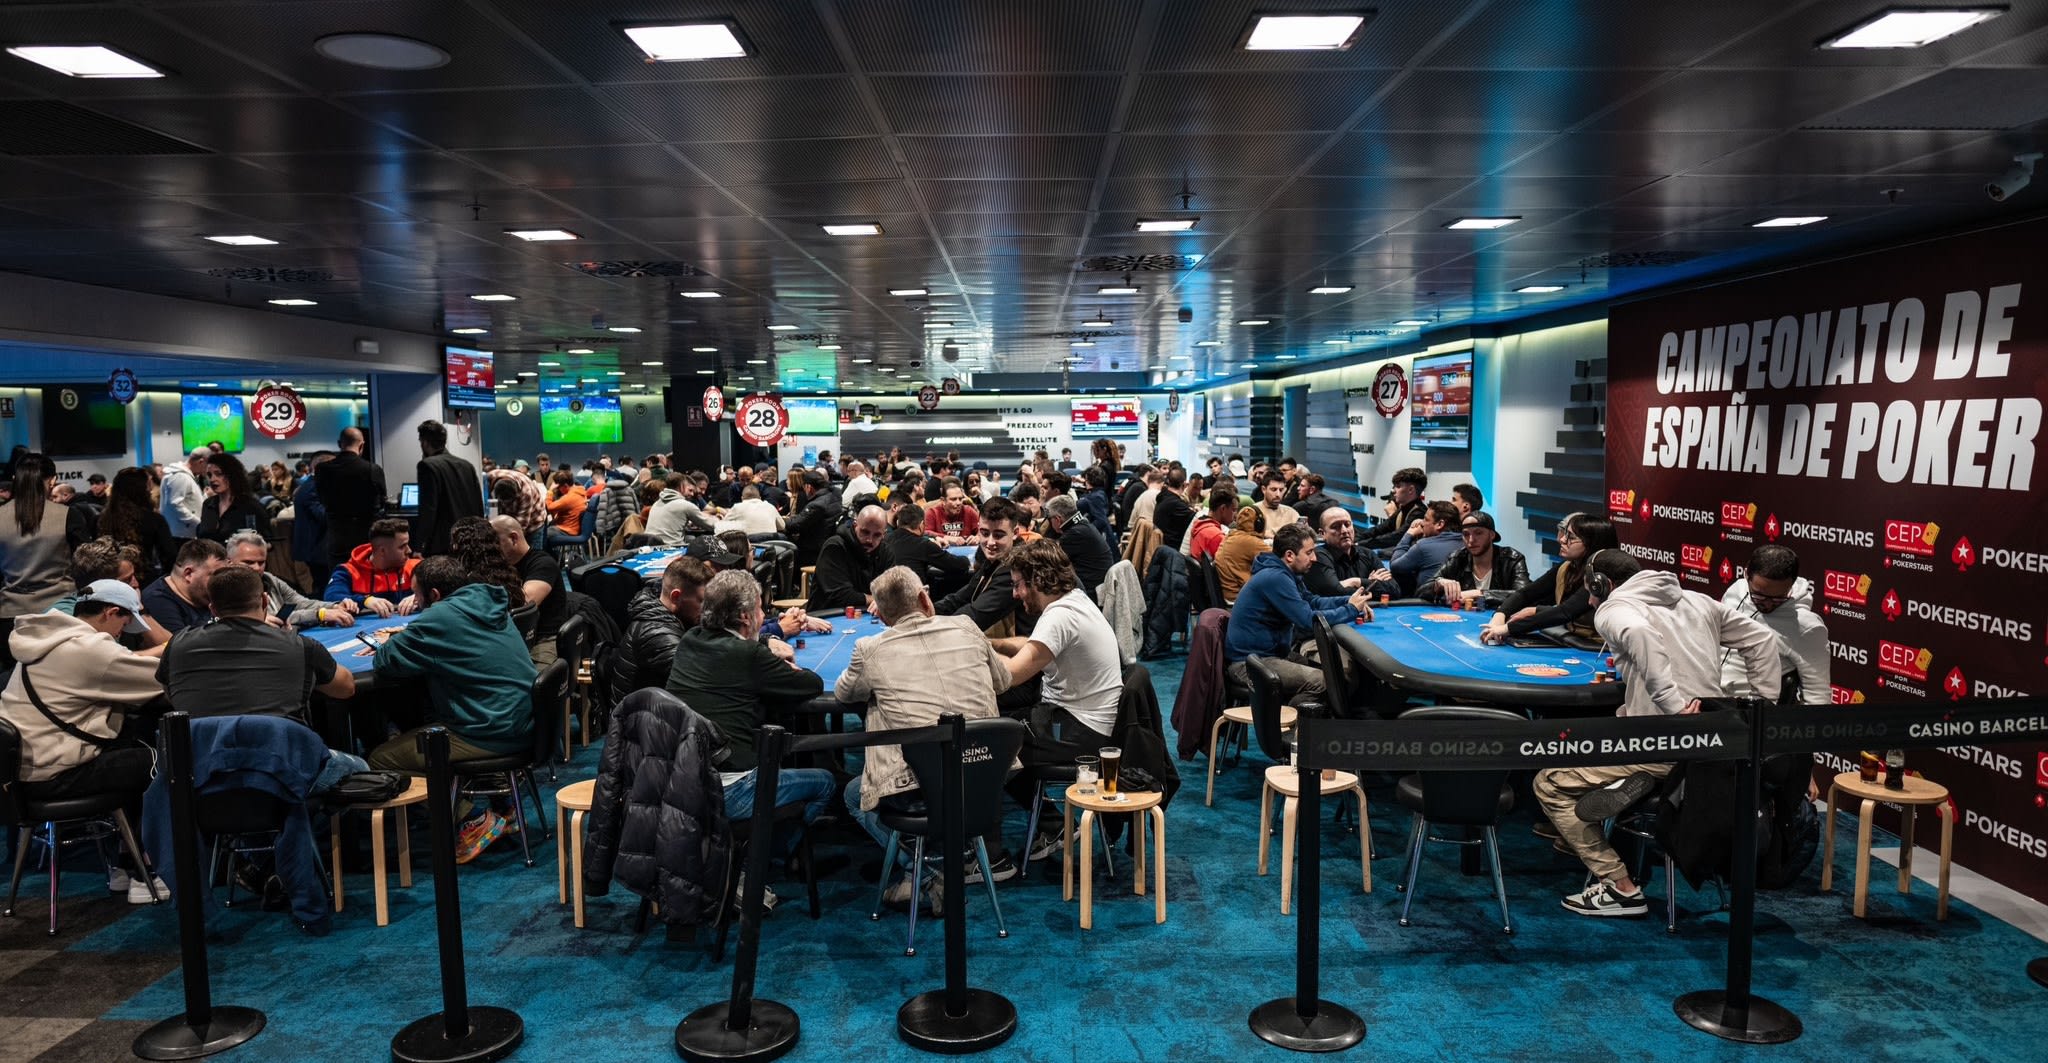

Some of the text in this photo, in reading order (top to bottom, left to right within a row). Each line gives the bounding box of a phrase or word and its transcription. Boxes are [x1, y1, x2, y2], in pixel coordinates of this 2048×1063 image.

[1656, 283, 2022, 394] CAMPEONATO DE
[116, 380, 130, 392] 32
[1380, 380, 1398, 399] 27
[66, 394, 72, 404] 3
[708, 398, 718, 408] 26
[744, 398, 780, 410] POKER ROOM
[924, 392, 934, 401] 22
[264, 402, 292, 420] 29
[749, 410, 776, 427] 28
[1642, 392, 2042, 491] ESPAÑA DE POKER
[58, 470, 84, 480] TACK
[1610, 491, 1627, 504] CEP
[1653, 504, 1714, 524] POKERSTARS
[1722, 504, 1746, 520] CEP
[1726, 534, 1752, 543] POKERSTARS
[1783, 521, 1874, 548] POKERSTARS
[1886, 522, 1922, 543] CEP
[1620, 542, 1675, 564] POKERSTARS
[1682, 546, 1702, 562] CEP
[1982, 546, 2048, 574] POKER
[1892, 560, 1934, 572] POKERSTARS
[1686, 573, 1710, 584] POKERSTARS
[1826, 572, 1856, 592] CEP
[1830, 608, 1866, 620] POKERSTARS
[1907, 600, 2032, 642] POKERSTARS
[1880, 644, 1914, 666] CEP
[1894, 674, 1908, 682] POR
[1831, 687, 1849, 704] EP
[1886, 680, 1926, 698] POKERSTARS
[1909, 716, 2048, 738] CASINO BARCEL
[962, 746, 988, 758] SINO
[1520, 733, 1724, 756] CASINO BARCELONA
[962, 754, 992, 763] CELONA
[1965, 809, 2048, 858] POKERS
